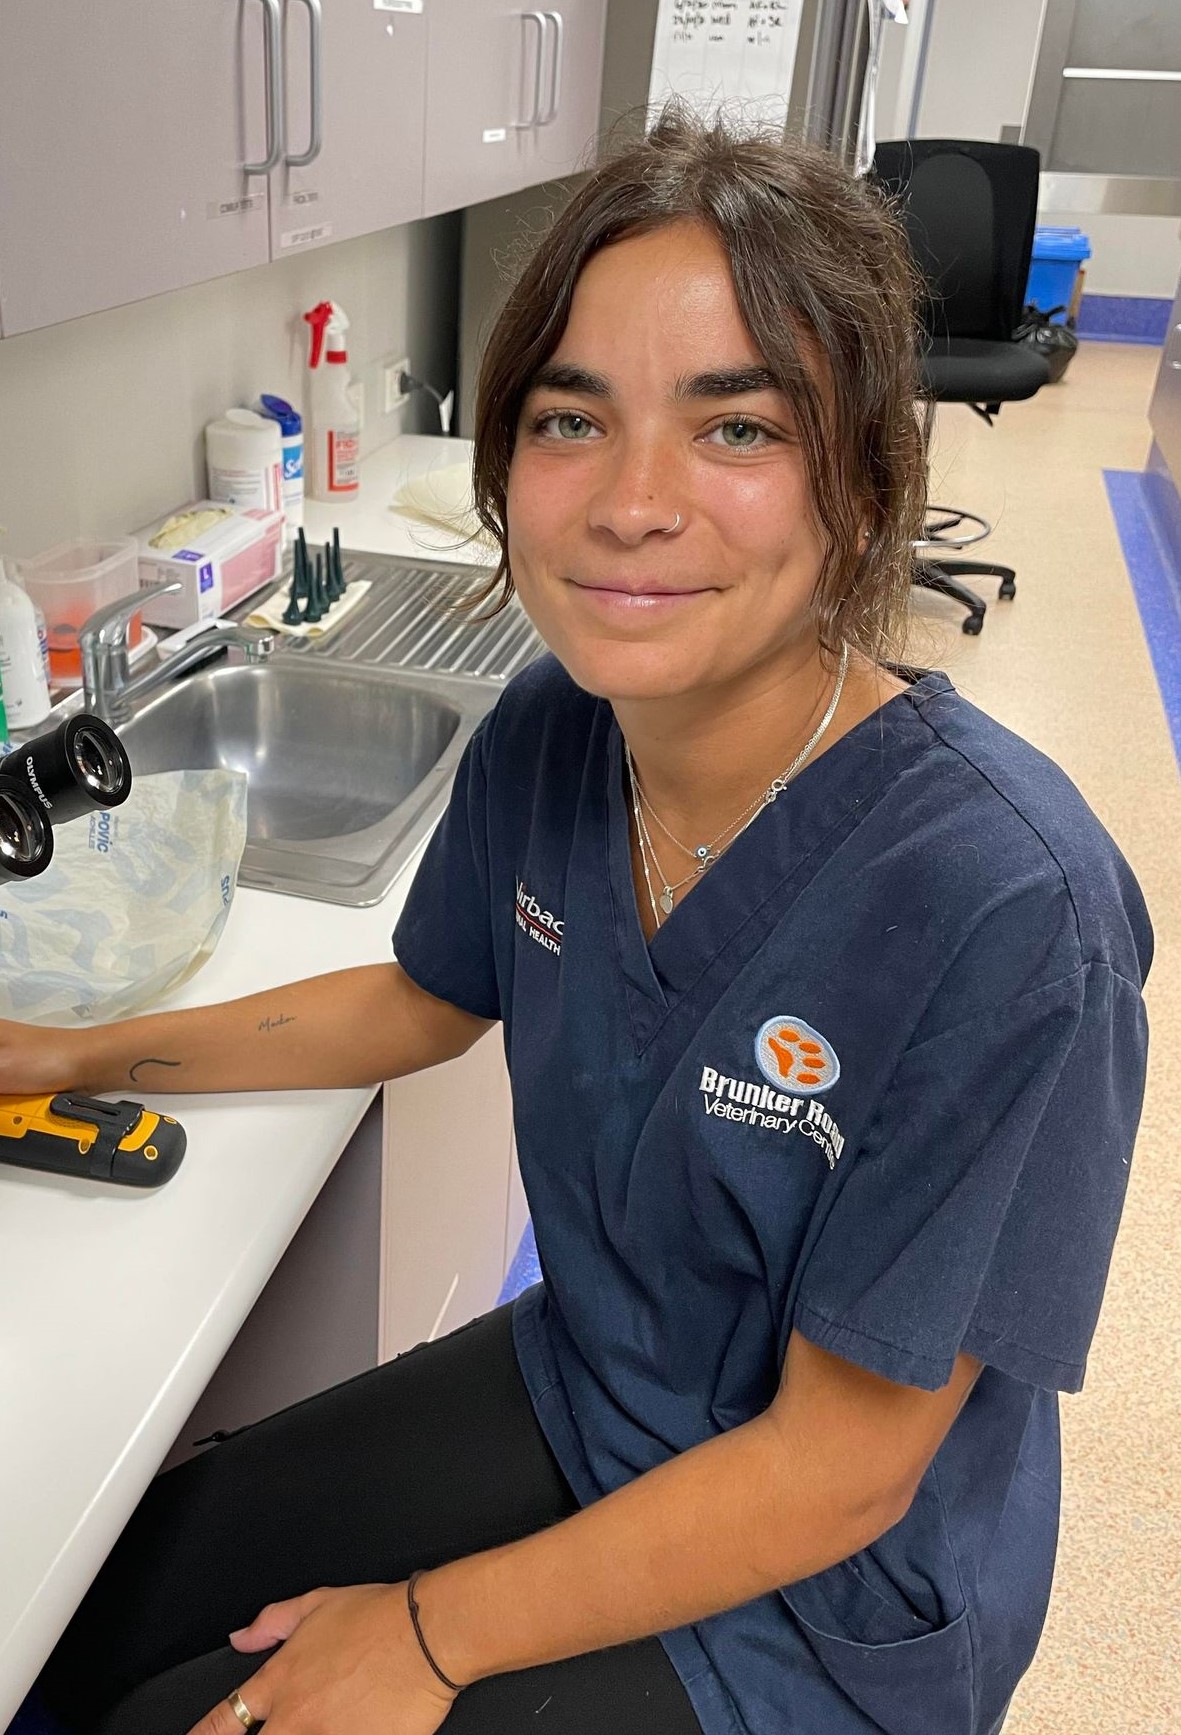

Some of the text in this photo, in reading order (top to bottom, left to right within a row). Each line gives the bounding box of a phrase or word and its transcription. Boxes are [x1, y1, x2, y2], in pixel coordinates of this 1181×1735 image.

[26, 756, 53, 809] OLYMPUS
[529, 926, 561, 956] HEALTH
[699, 1066, 805, 1117] Brunker
[703, 1093, 798, 1134] Veterinary
